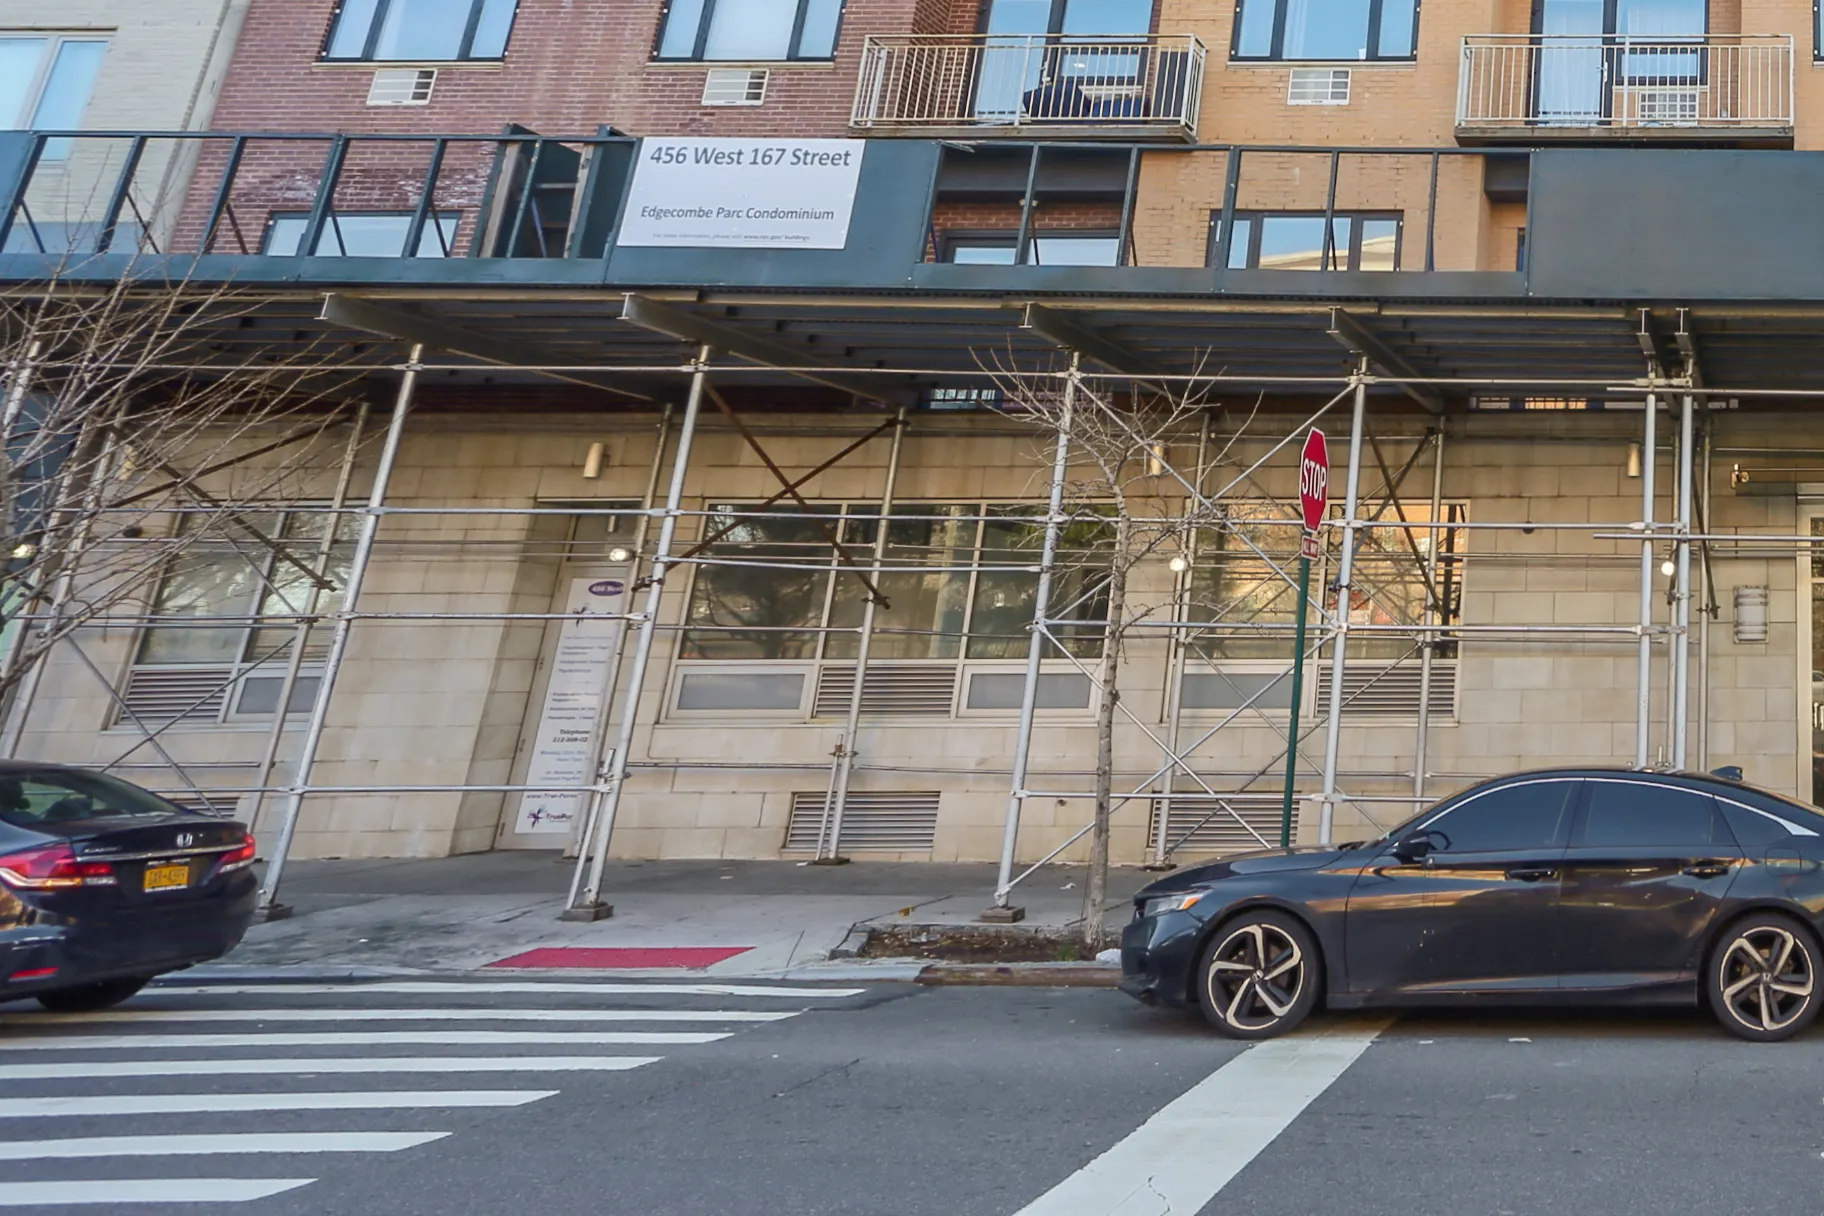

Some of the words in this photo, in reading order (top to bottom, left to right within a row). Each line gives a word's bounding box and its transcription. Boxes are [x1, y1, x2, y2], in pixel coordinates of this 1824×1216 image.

[650, 146, 688, 165] 456
[694, 146, 744, 166] West
[749, 147, 787, 166] 167
[789, 147, 852, 167] Street
[640, 205, 713, 221] Edgecombe
[716, 206, 744, 219] Parc
[746, 207, 835, 221] Condominium
[1302, 458, 1327, 502] STOP
